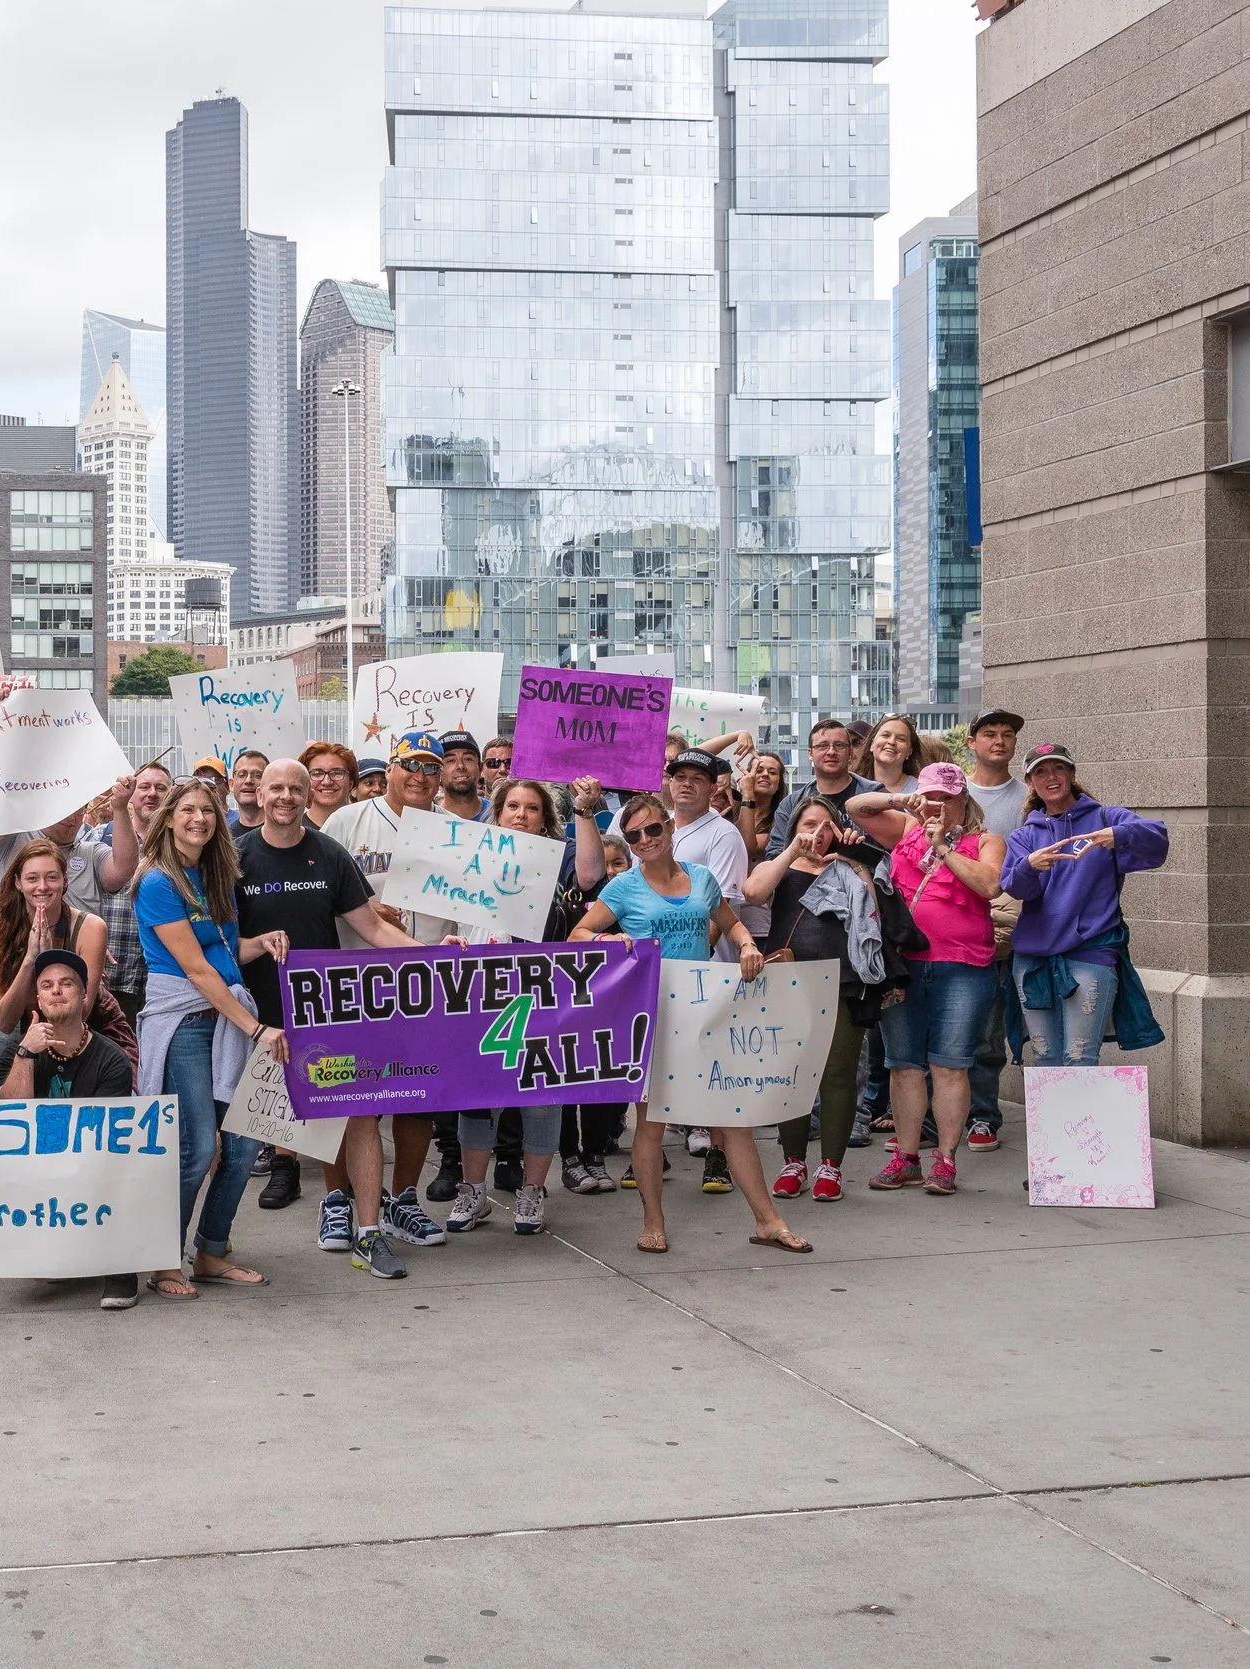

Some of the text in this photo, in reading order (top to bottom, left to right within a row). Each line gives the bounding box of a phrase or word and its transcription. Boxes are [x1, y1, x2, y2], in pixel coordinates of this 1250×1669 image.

[198, 675, 285, 714] Recovery
[374, 665, 476, 713] Recovery
[520, 678, 666, 713] SOMEONE'S
[673, 692, 710, 713] The
[52, 710, 94, 729] works
[225, 713, 243, 733] is
[404, 708, 436, 731] IS
[554, 716, 618, 745] MOM
[440, 820, 517, 856] I AM
[462, 853, 482, 876] A
[243, 880, 328, 896] We DO Recover.
[421, 873, 499, 911] Miracle
[287, 950, 608, 1029] RECOVERY
[688, 968, 768, 1005] I AM
[479, 993, 535, 1071] 4
[729, 1025, 784, 1056] NOT
[517, 1011, 650, 1092] ALL!
[313, 1062, 440, 1084] Recovery Alliance
[247, 1086, 306, 1126] STIG
[309, 1088, 427, 1104] www.warecoveryalliance.org
